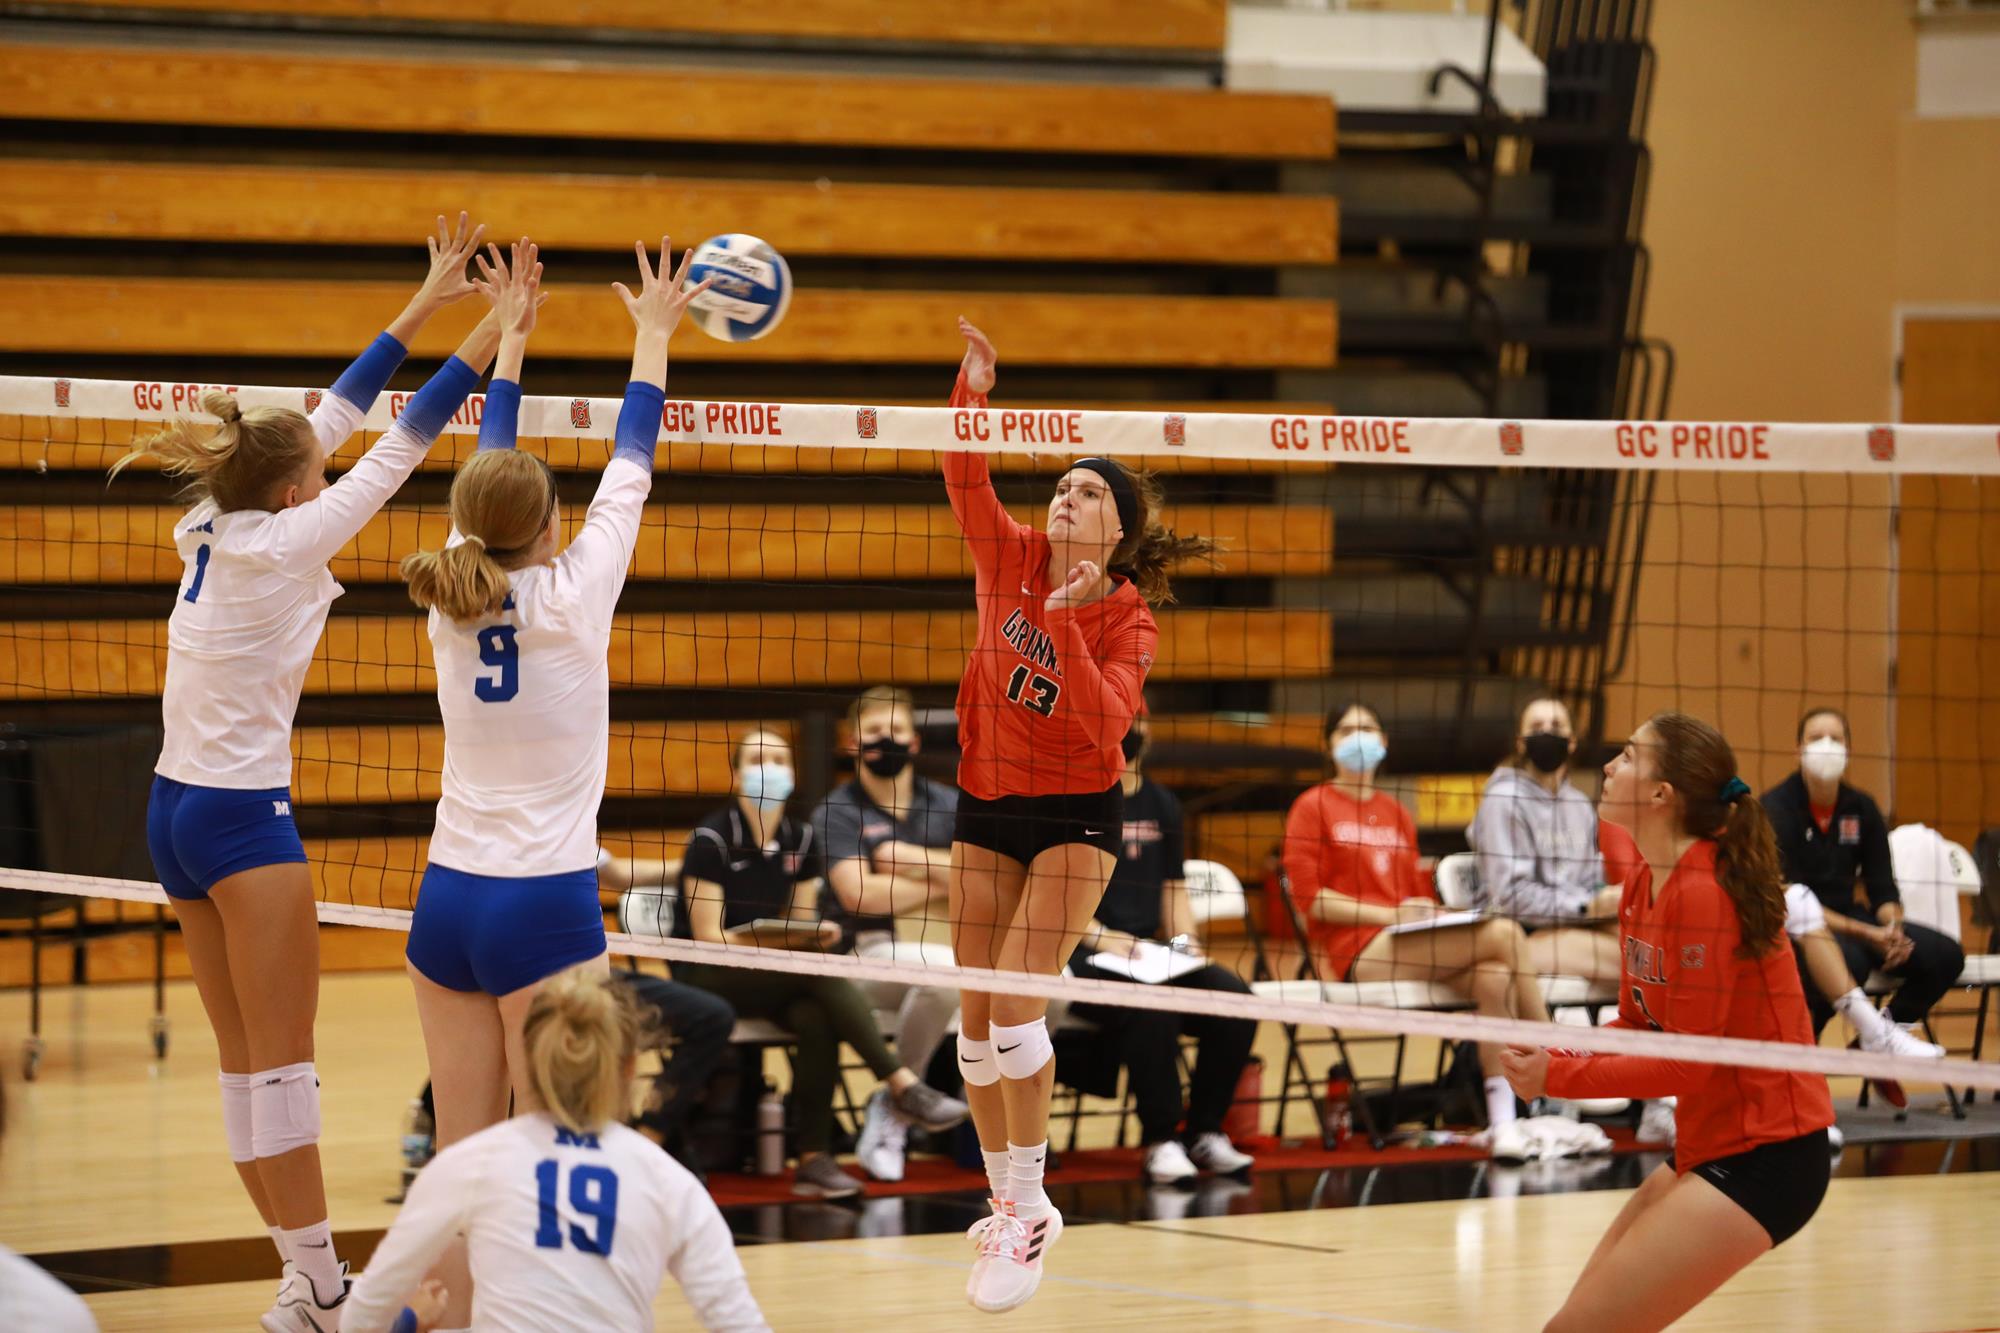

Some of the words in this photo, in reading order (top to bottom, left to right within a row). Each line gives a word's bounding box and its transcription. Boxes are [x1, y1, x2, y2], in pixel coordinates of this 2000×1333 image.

[133, 383, 163, 411] GC
[662, 401, 696, 433] GC
[705, 403, 782, 436] PRIDE
[954, 410, 990, 442] GC
[1001, 411, 1084, 444] PRIDE
[1270, 418, 1309, 451] GC
[1321, 419, 1411, 454] PRIDE
[1616, 424, 1658, 458] GC
[1671, 425, 1770, 460] PRIDE
[183, 543, 210, 603] 1
[1001, 607, 1063, 679] GRINN
[474, 625, 519, 703] 9
[1006, 663, 1060, 718] 13
[272, 800, 290, 817] M
[535, 1158, 619, 1258] 19
